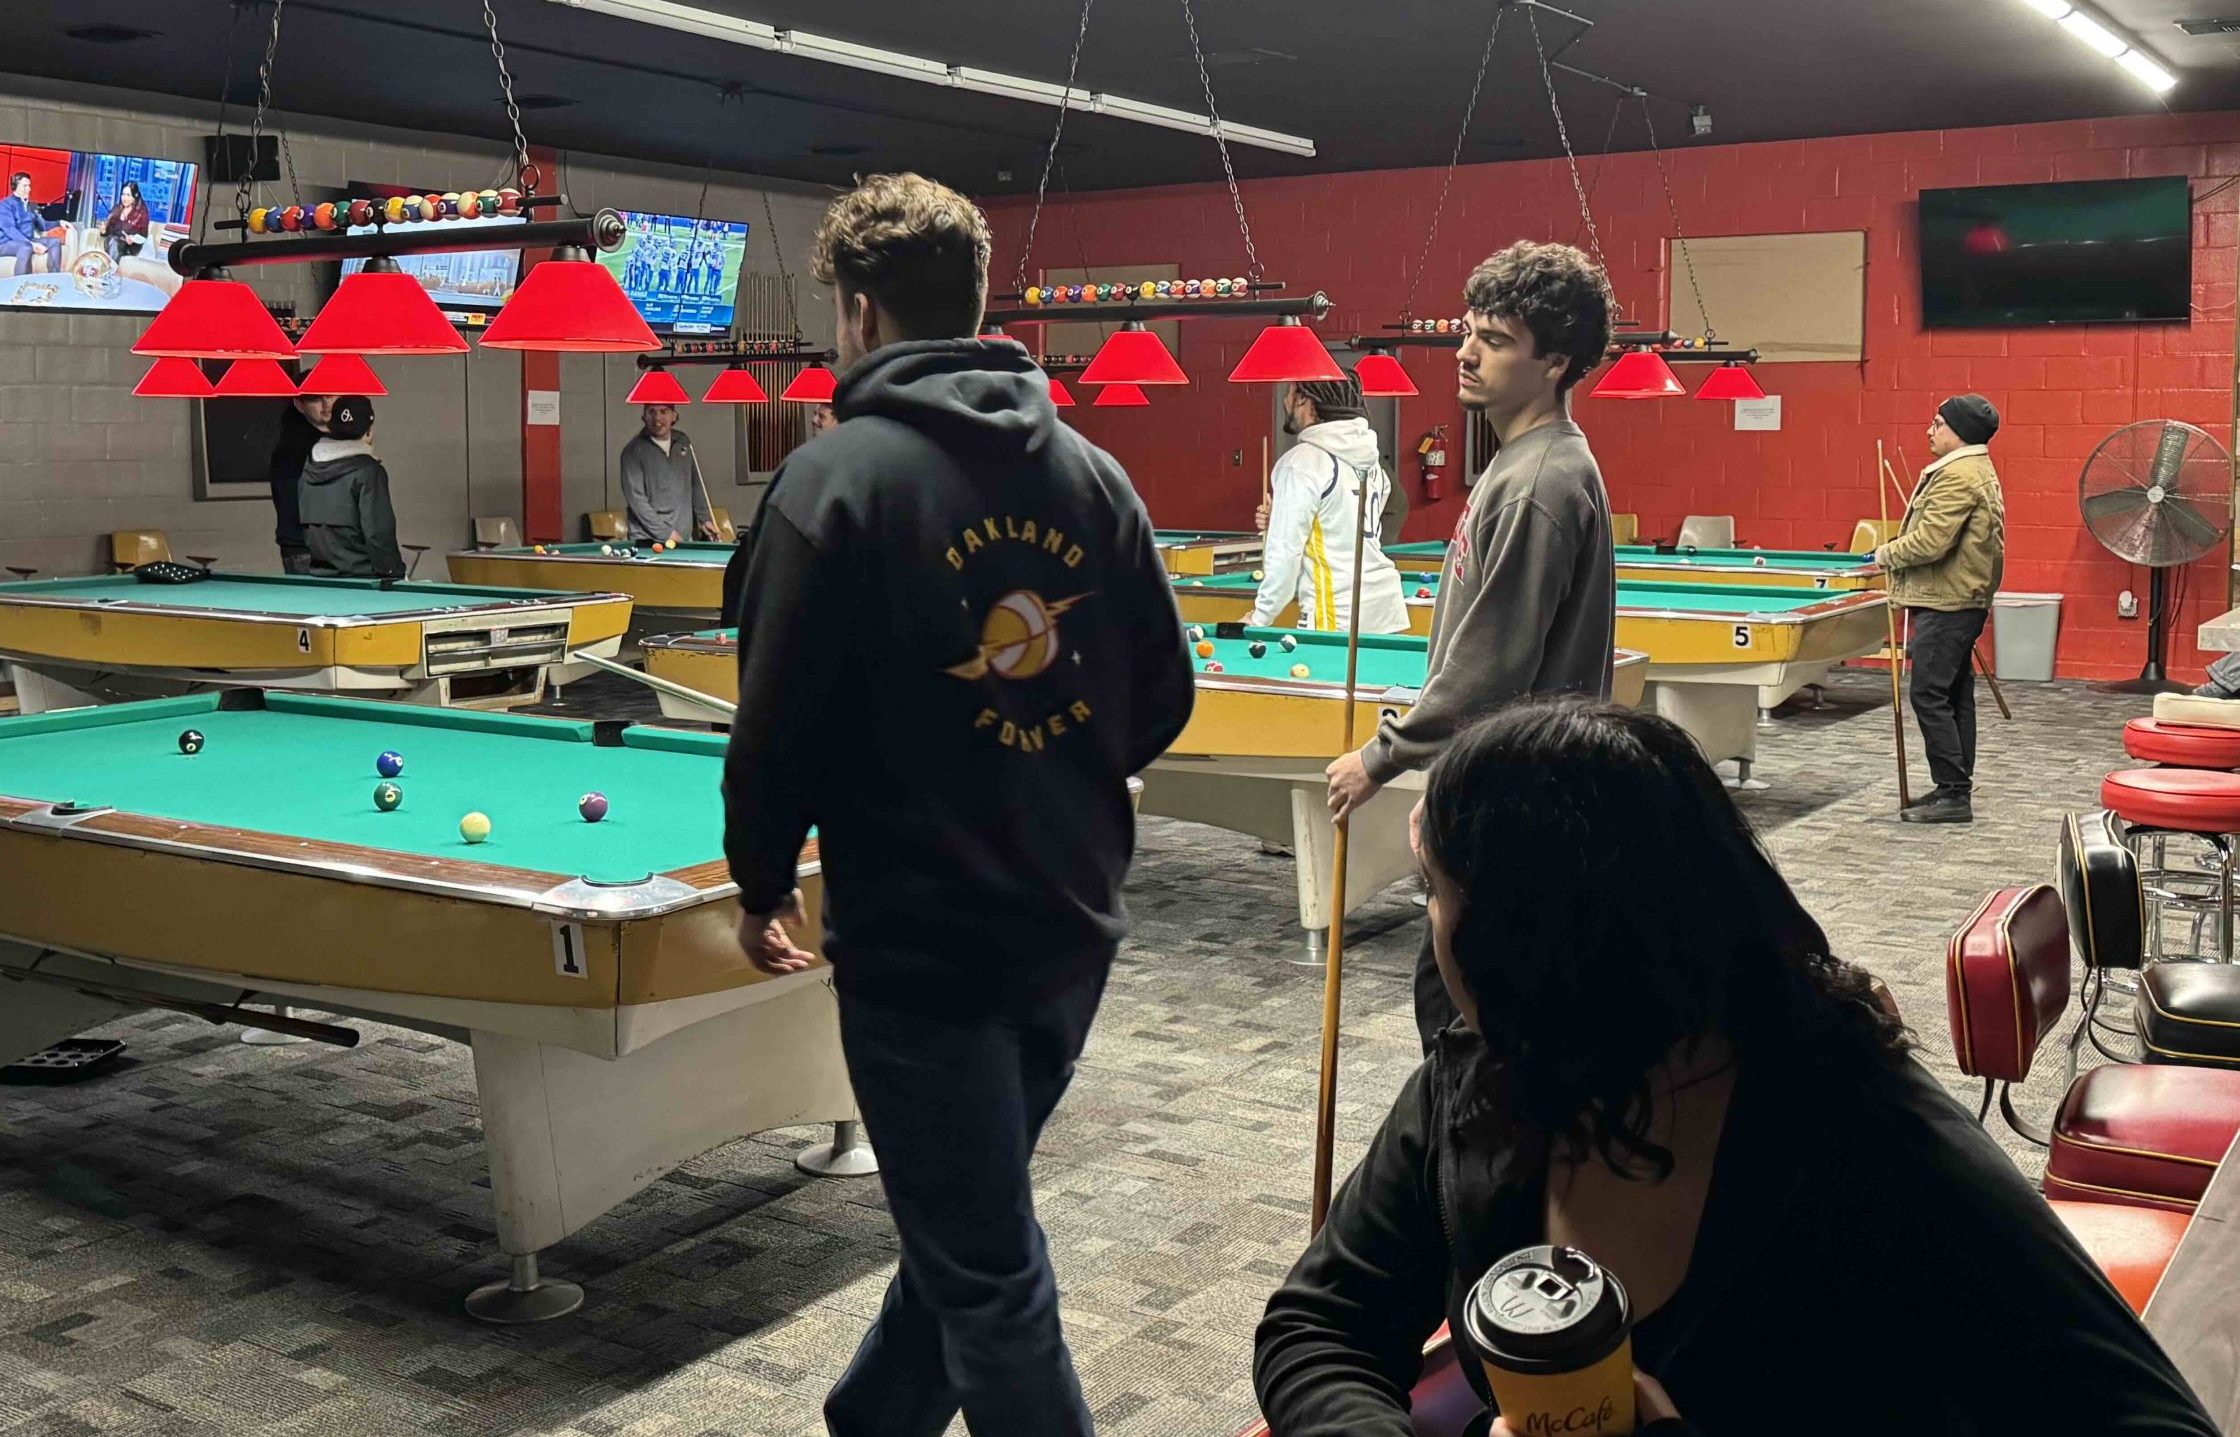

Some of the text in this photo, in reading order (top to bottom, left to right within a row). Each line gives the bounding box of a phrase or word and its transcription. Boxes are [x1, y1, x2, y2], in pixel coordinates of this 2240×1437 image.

[946, 516, 1085, 570] OAKLAND
[1815, 578, 1827, 589] 7
[299, 630, 310, 651] 4
[1735, 626, 1750, 647] 5
[974, 700, 1093, 753] POWER
[559, 924, 580, 974] 1
[1526, 1394, 1615, 1437] McCafé
